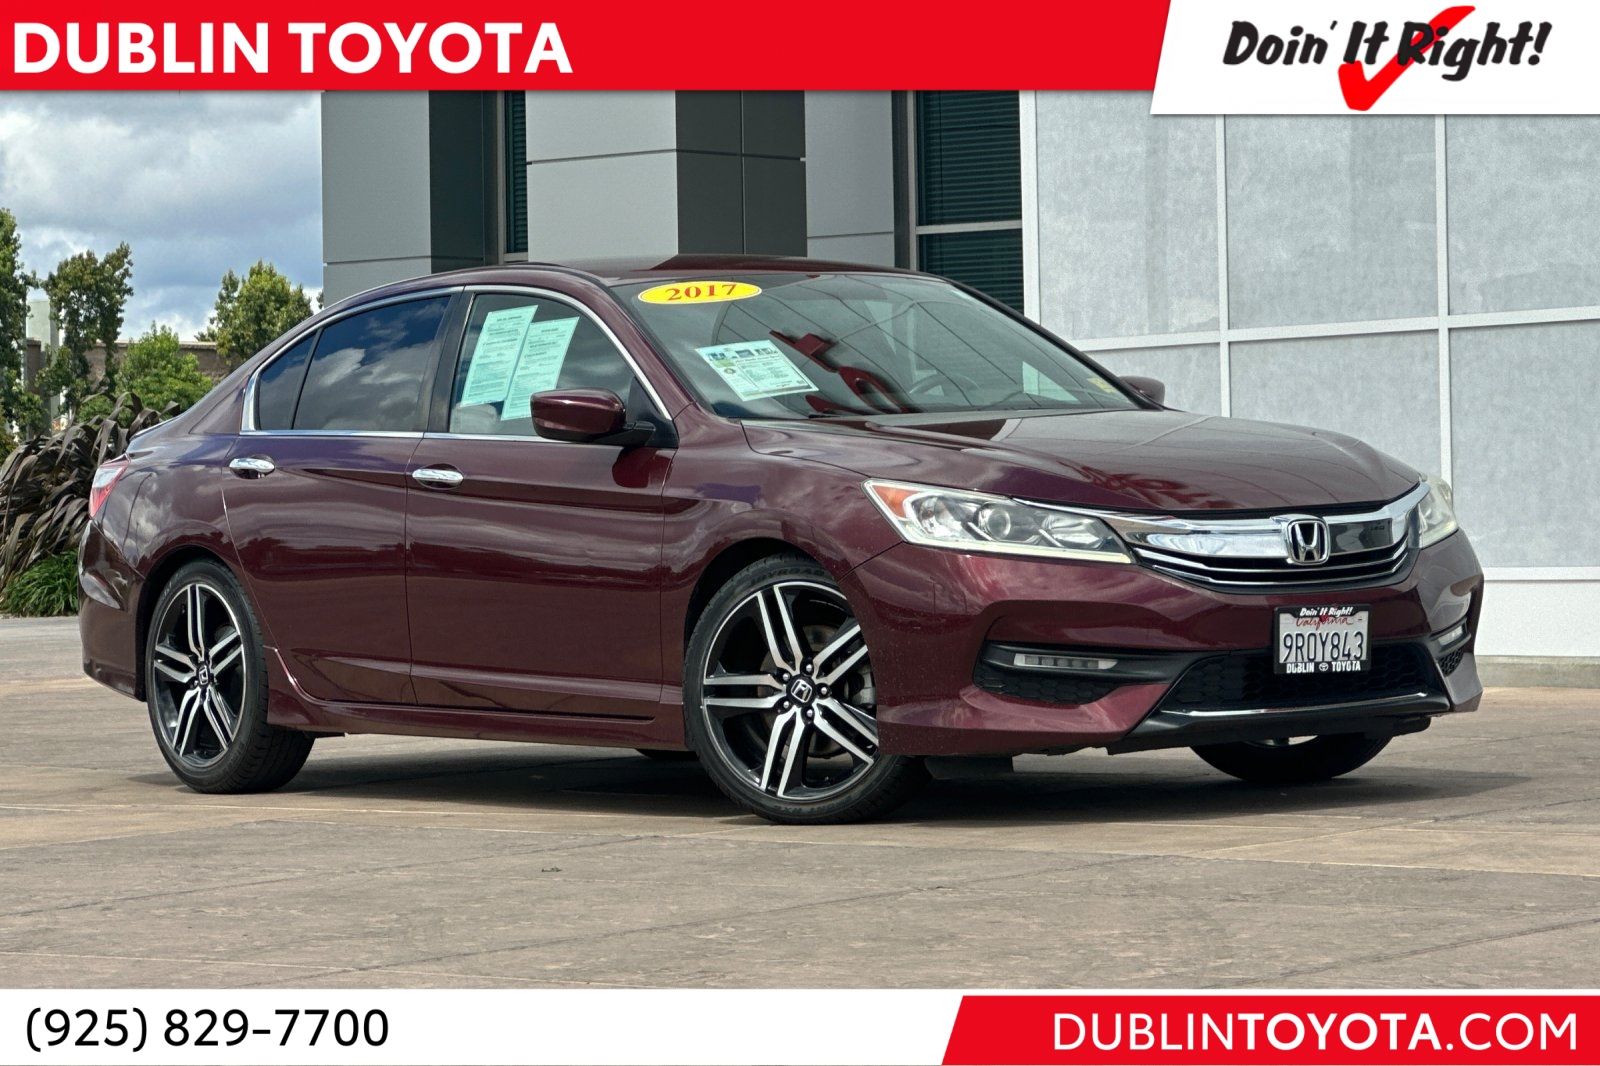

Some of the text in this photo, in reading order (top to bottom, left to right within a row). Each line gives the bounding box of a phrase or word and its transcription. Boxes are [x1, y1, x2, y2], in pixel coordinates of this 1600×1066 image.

[665, 284, 737, 301] 2017
[1328, 607, 1353, 617] Right!
[1283, 631, 1364, 662] 9ROY843
[1286, 661, 1360, 673] DUBLIN TOYOTA
